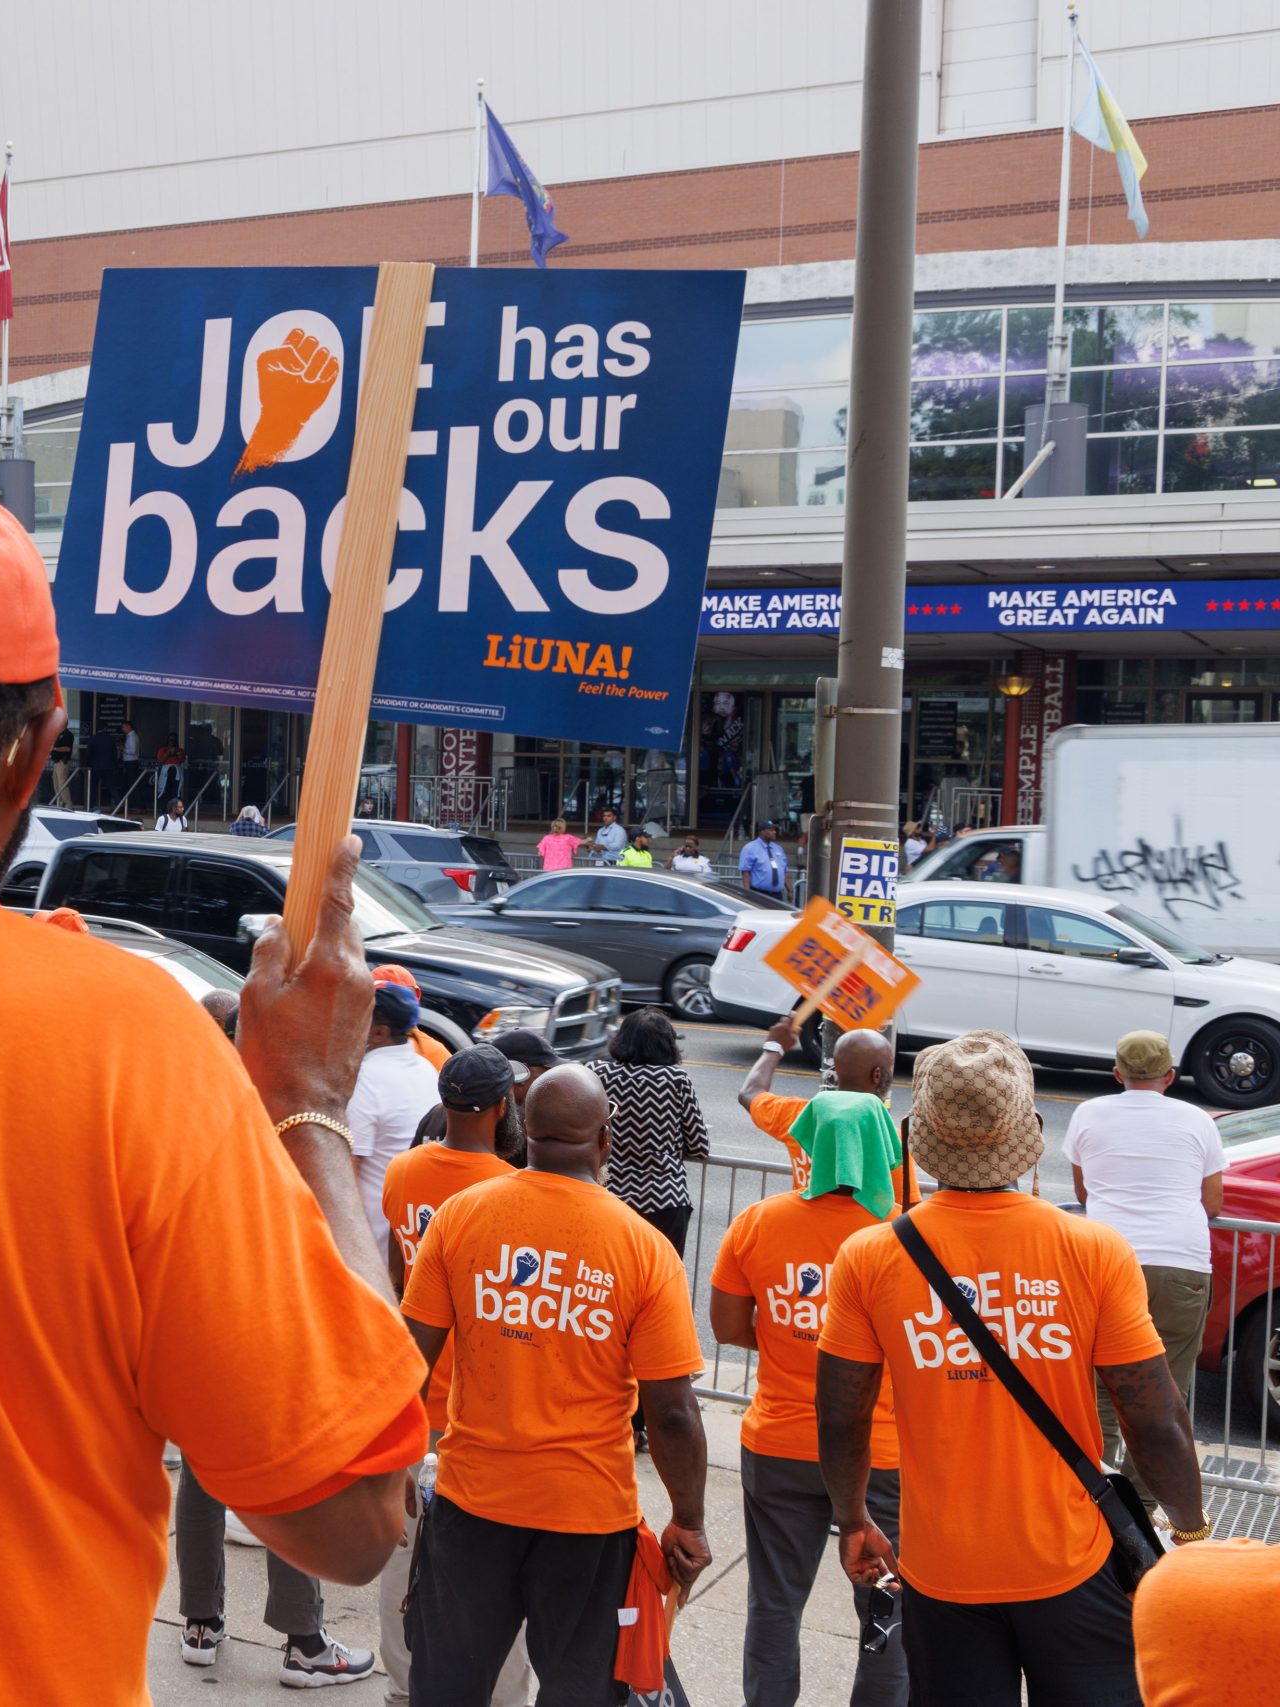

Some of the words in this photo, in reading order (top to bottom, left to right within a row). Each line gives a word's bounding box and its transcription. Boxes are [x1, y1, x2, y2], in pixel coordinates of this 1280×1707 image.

[498, 306, 651, 382] has
[493, 394, 637, 454] our
[701, 595, 762, 612] MAKE
[988, 588, 1057, 608] MAKE
[1062, 588, 1177, 607] AMERICA
[710, 612, 781, 628] GREAT
[999, 610, 1080, 627] GREAT
[1084, 607, 1164, 625] AGAIN
[483, 634, 633, 680] LiUNA!
[68, 667, 80, 675] FOR
[117, 672, 161, 683] INTERNATIONAL
[162, 677, 182, 685] UNION
[191, 680, 212, 688] NORTH
[212, 682, 240, 690] AMERICA
[297, 690, 311, 698] NOT
[373, 697, 408, 708] CANDIDATE
[419, 702, 460, 713] CANDIDATE'S
[578, 681, 604, 696] Feel
[605, 683, 626, 697] the
[628, 686, 669, 701] Power
[838, 901, 896, 923] STR
[485, 1243, 567, 1293] JOE
[577, 1259, 615, 1288] has
[574, 1283, 610, 1304] our
[1014, 1272, 1060, 1297] has
[474, 1273, 614, 1341] backs
[1016, 1299, 1058, 1317] our
